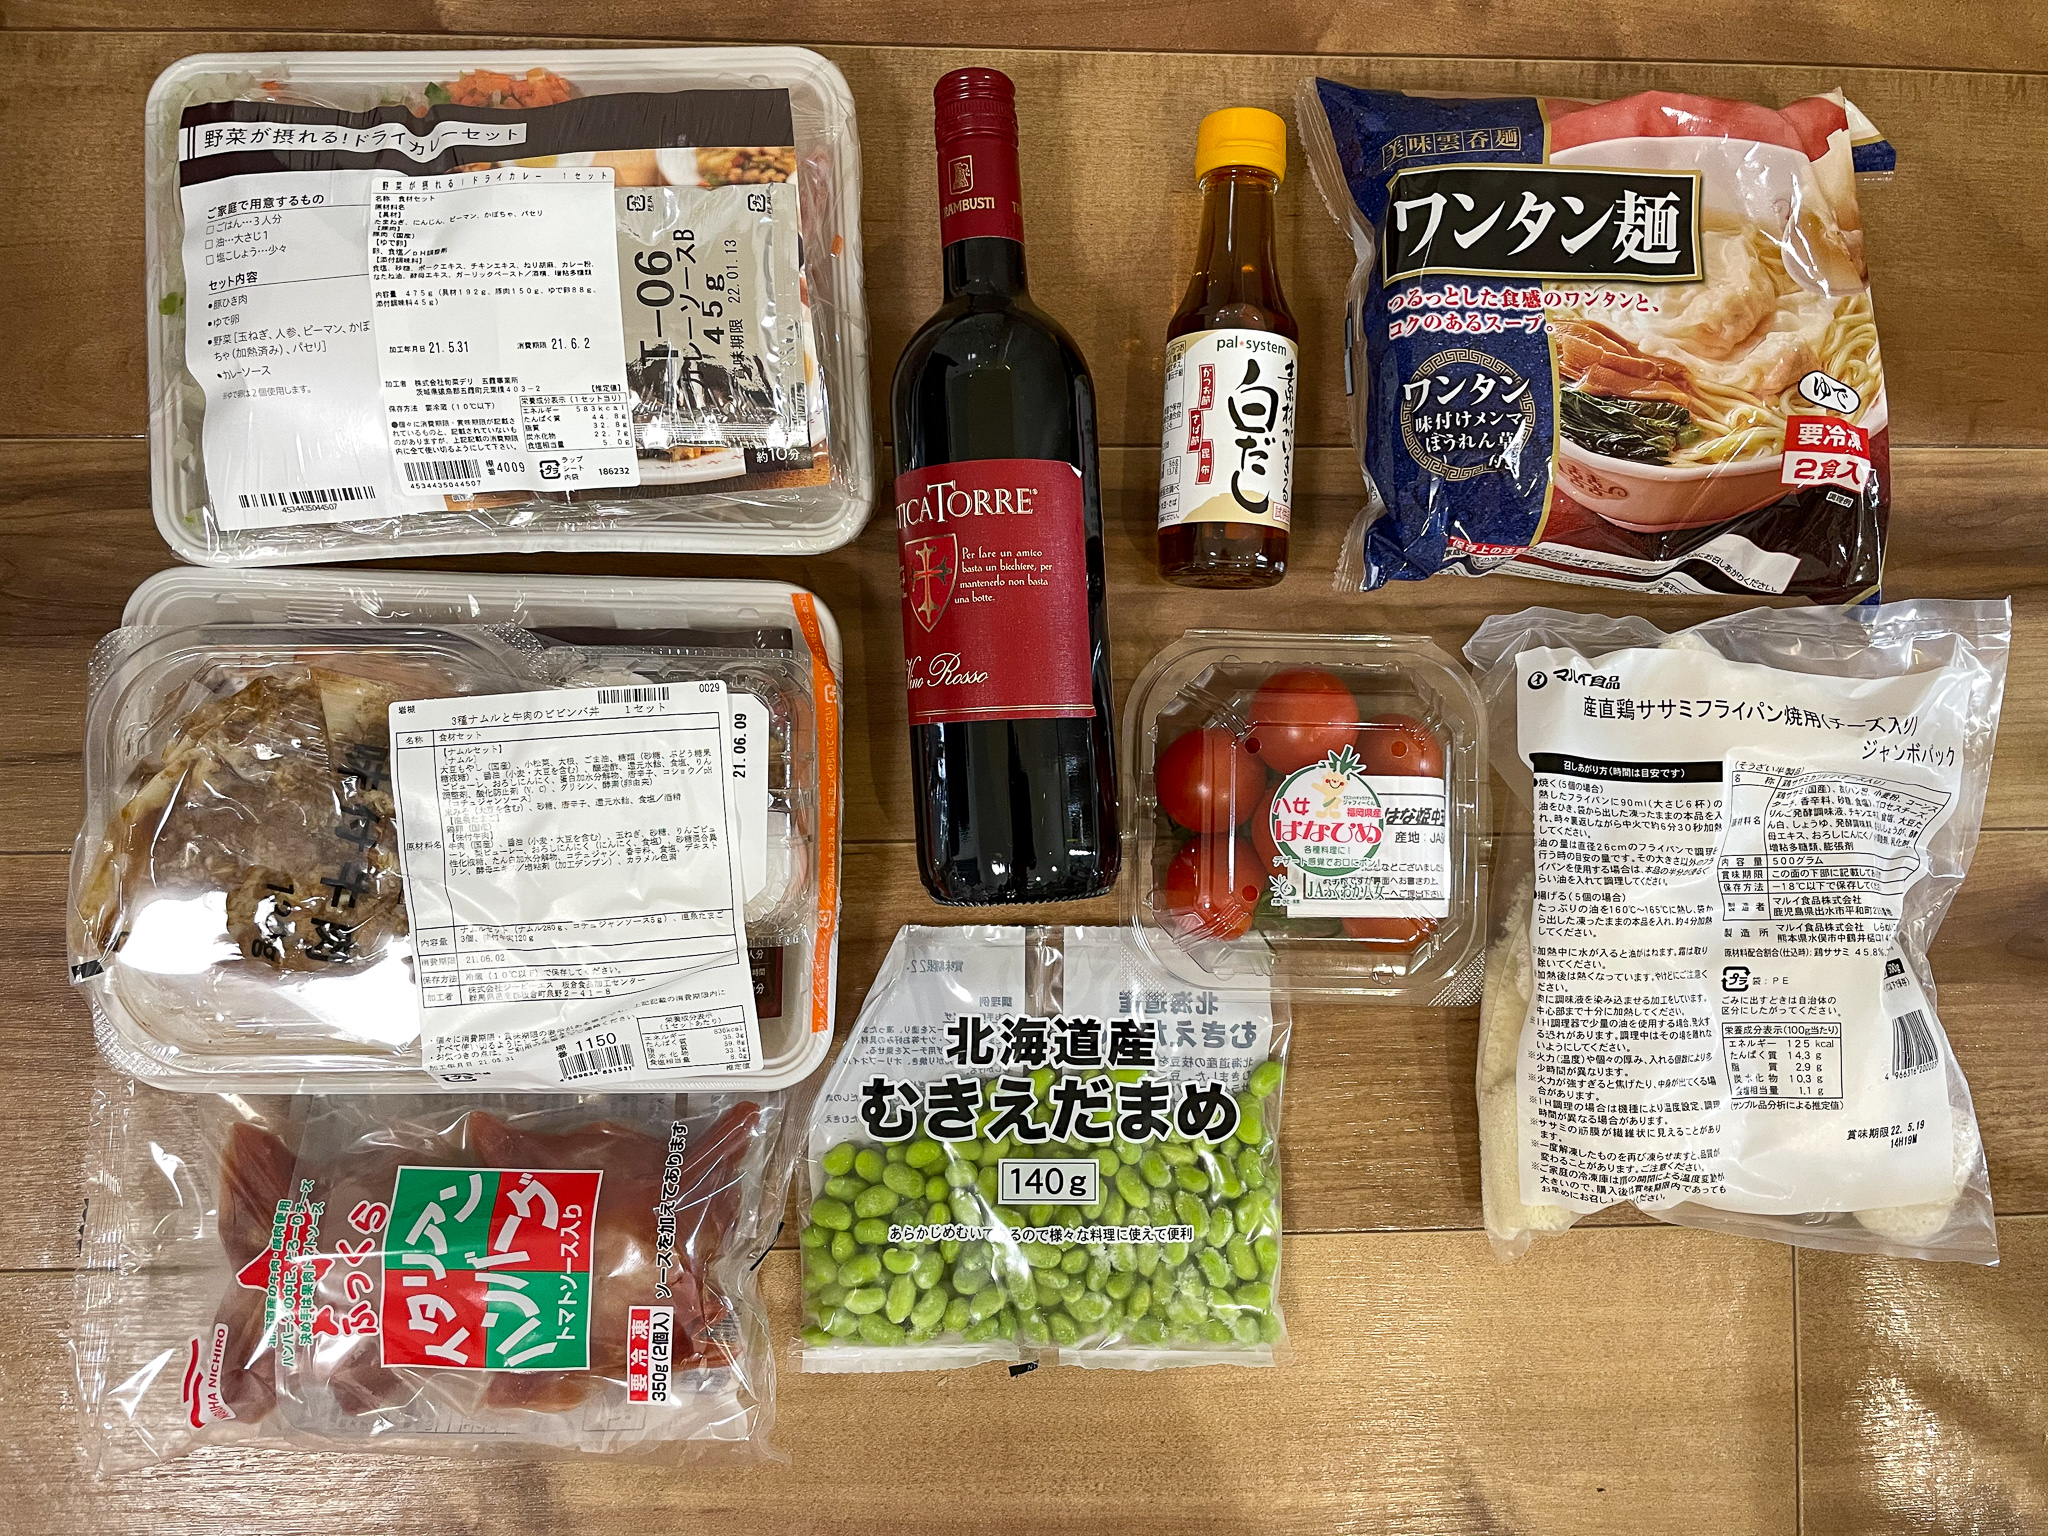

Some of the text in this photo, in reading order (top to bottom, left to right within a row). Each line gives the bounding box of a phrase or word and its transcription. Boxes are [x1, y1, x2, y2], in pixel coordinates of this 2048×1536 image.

[207, 194, 324, 220] ご家庭で用意するもの
[1394, 190, 1681, 264] ワンタン麺
[208, 271, 258, 291] セット内容
[214, 295, 248, 310] 豚ひき肉
[214, 314, 240, 326] ゆで卵
[390, 345, 425, 353] 加工年月日
[1246, 339, 1287, 356] system
[222, 366, 270, 380] カレーソース
[1201, 368, 1212, 406] かつお節
[1403, 374, 1529, 413] ワンタン
[1814, 376, 1848, 409] ゆで
[1415, 411, 1523, 433] 味付けメンマ
[1228, 359, 1279, 514] 白だし
[1798, 423, 1862, 451] 要冷凍
[497, 462, 525, 472] 4009
[1201, 448, 1210, 474] 昆布
[599, 467, 629, 475] 186232
[1794, 458, 1861, 485] 2食入
[962, 547, 975, 559] Per
[978, 546, 996, 558] fare
[1016, 548, 1042, 557] amico
[962, 562, 982, 573] basta
[1041, 562, 1052, 572] per
[960, 574, 1004, 588] mantenerlo
[1028, 574, 1048, 586] basta
[955, 595, 969, 603] una
[928, 653, 988, 687] Rosso
[699, 684, 720, 692] 0029
[1554, 669, 1620, 690] マルイ食品
[406, 732, 482, 744] 名称 食材セット
[733, 713, 746, 778] 21.06.09
[1861, 740, 1955, 765] ジャンボパック
[1274, 798, 1382, 817] 八女 福岡県産
[1539, 826, 1591, 838] してください。
[1722, 857, 1823, 866] 内容量 500グラム
[1722, 869, 1763, 879] 賞味期限
[1723, 882, 1764, 891] 保存方法
[1773, 895, 1861, 905] マルイ食品株式会社
[1724, 923, 1864, 937] 製造所 マルイ食品株式会社
[421, 938, 448, 946] 内容量
[1538, 959, 1606, 969] 除いてください。
[1722, 996, 1836, 1005] ごみに出すときは自治体の
[1722, 1006, 1841, 1016] 区分にしたがってください。
[576, 1033, 616, 1051] 1150
[947, 1017, 1156, 1067] 北海道産
[1537, 1042, 1630, 1052] いようにしてください。
[1729, 1040, 1834, 1048] エネルギー 125 kcal
[1731, 1051, 1777, 1060] たんぱく質
[1788, 1051, 1810, 1060] 14.3
[1537, 1065, 1629, 1077] 少時間が異なります。
[1538, 1086, 1599, 1100] 合があります。
[859, 1078, 1239, 1141] むきえだまめ
[1539, 1109, 1668, 1126] 時間が異なる場合があります。
[1540, 1131, 1562, 1142] ます。
[1847, 1127, 1889, 1140] 賞味期限
[1010, 1167, 1087, 1196] 140g
[657, 1122, 688, 1299] ソースを加えてあります
[890, 1224, 1193, 1243] あらかじめむいてるので様々な料理に使えて便利
[336, 1202, 388, 1336] ふっくら
[402, 1173, 483, 1365] イタリアン
[465, 1173, 558, 1367] ハンバーグ
[557, 1204, 583, 1341] トマトソース入り
[209, 1329, 225, 1387] NICHIRO
[631, 1317, 649, 1391] 要冷凍
